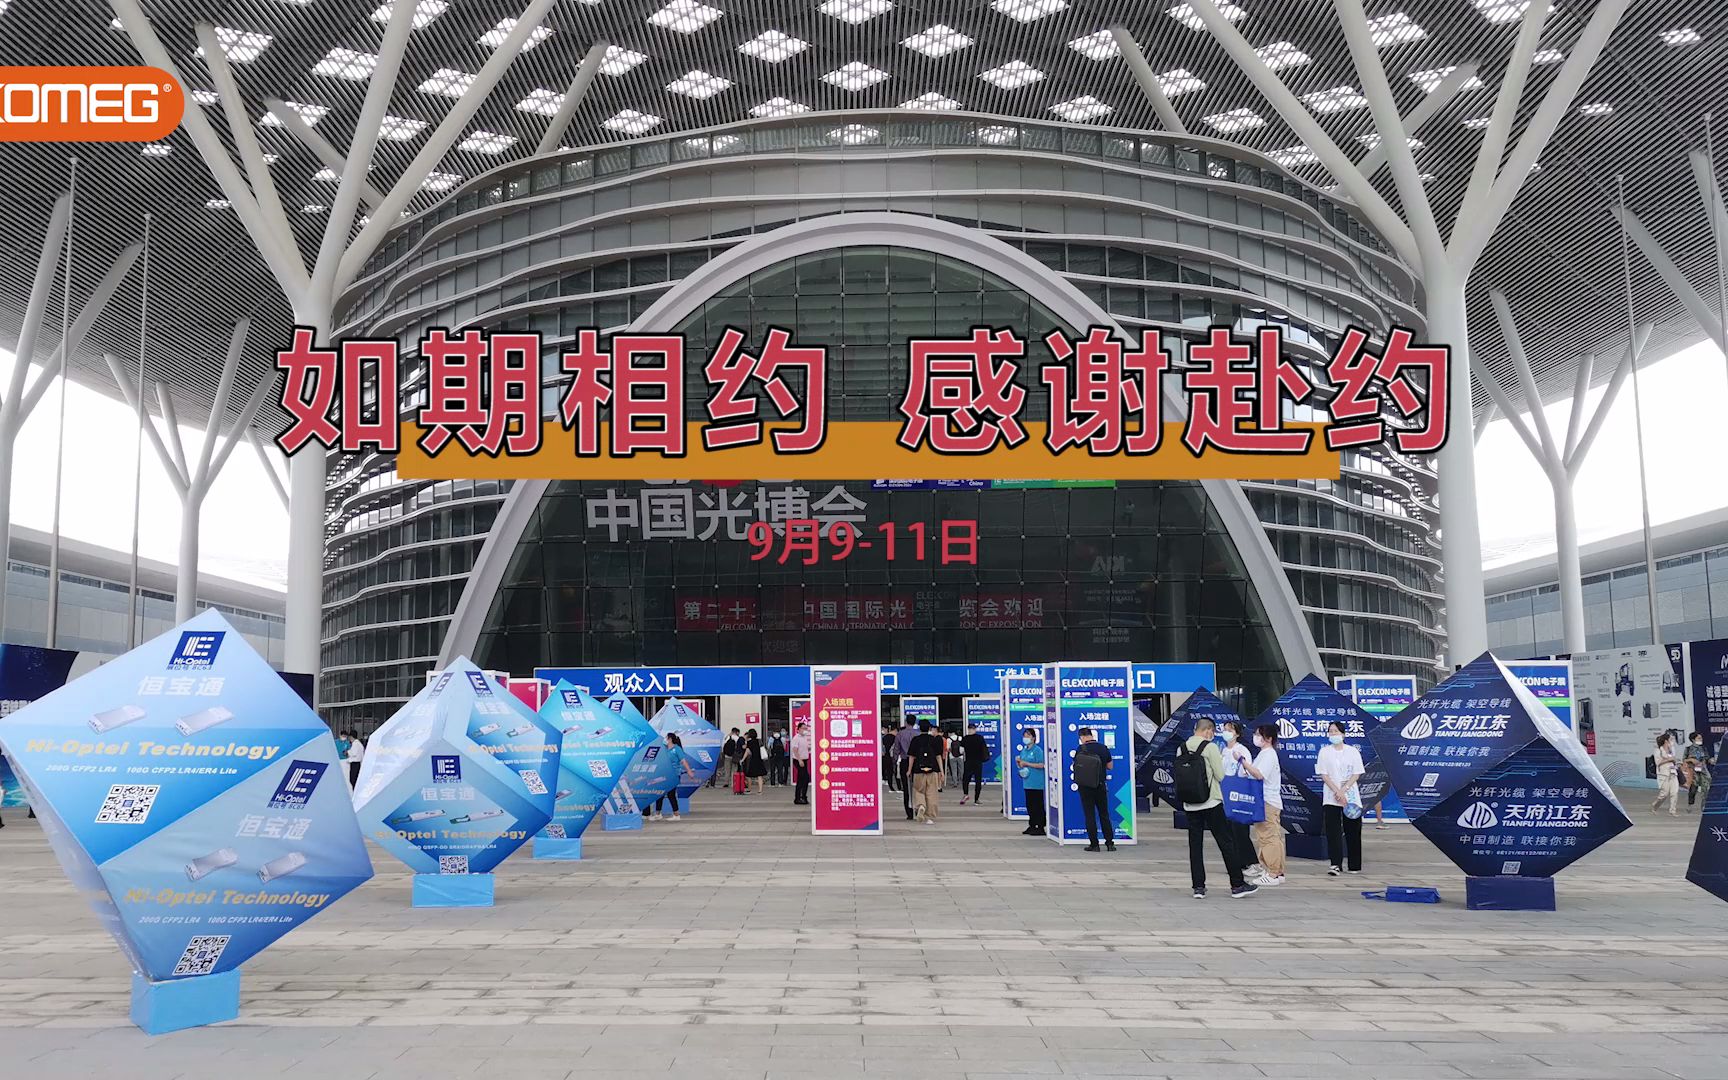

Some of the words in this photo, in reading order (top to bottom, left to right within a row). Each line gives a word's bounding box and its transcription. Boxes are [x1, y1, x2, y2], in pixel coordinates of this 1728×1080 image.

[586, 486, 868, 542] 中国光博会
[174, 657, 210, 666] Hi-Optel
[137, 676, 226, 696] 恒宝通
[604, 673, 684, 692] 观众入口
[994, 668, 1043, 679] 工作人员
[1131, 670, 1155, 689] 口
[1417, 699, 1461, 710] 光纤光缆
[1465, 697, 1512, 709] 架空导线
[1437, 714, 1511, 731] 天府江东
[25, 739, 130, 757] Hi-Optel
[138, 740, 279, 760] Technology
[1398, 745, 1441, 756] 中国制造
[1444, 746, 1491, 757] 联接你我
[219, 766, 238, 775] Lite
[275, 793, 307, 803] Hi-Optel
[1468, 786, 1526, 798] 光纤光缆
[1532, 787, 1589, 798] 架空导线
[1503, 804, 1592, 821] 天府江东
[234, 814, 313, 841] 恒宝通
[1502, 820, 1534, 828] TIANFU
[1535, 820, 1588, 828] JIANGDONG
[1459, 834, 1515, 846] 中国制造
[1521, 835, 1577, 847] 联接你我
[123, 887, 217, 907] Hi-Optel
[222, 888, 330, 908] Technology
